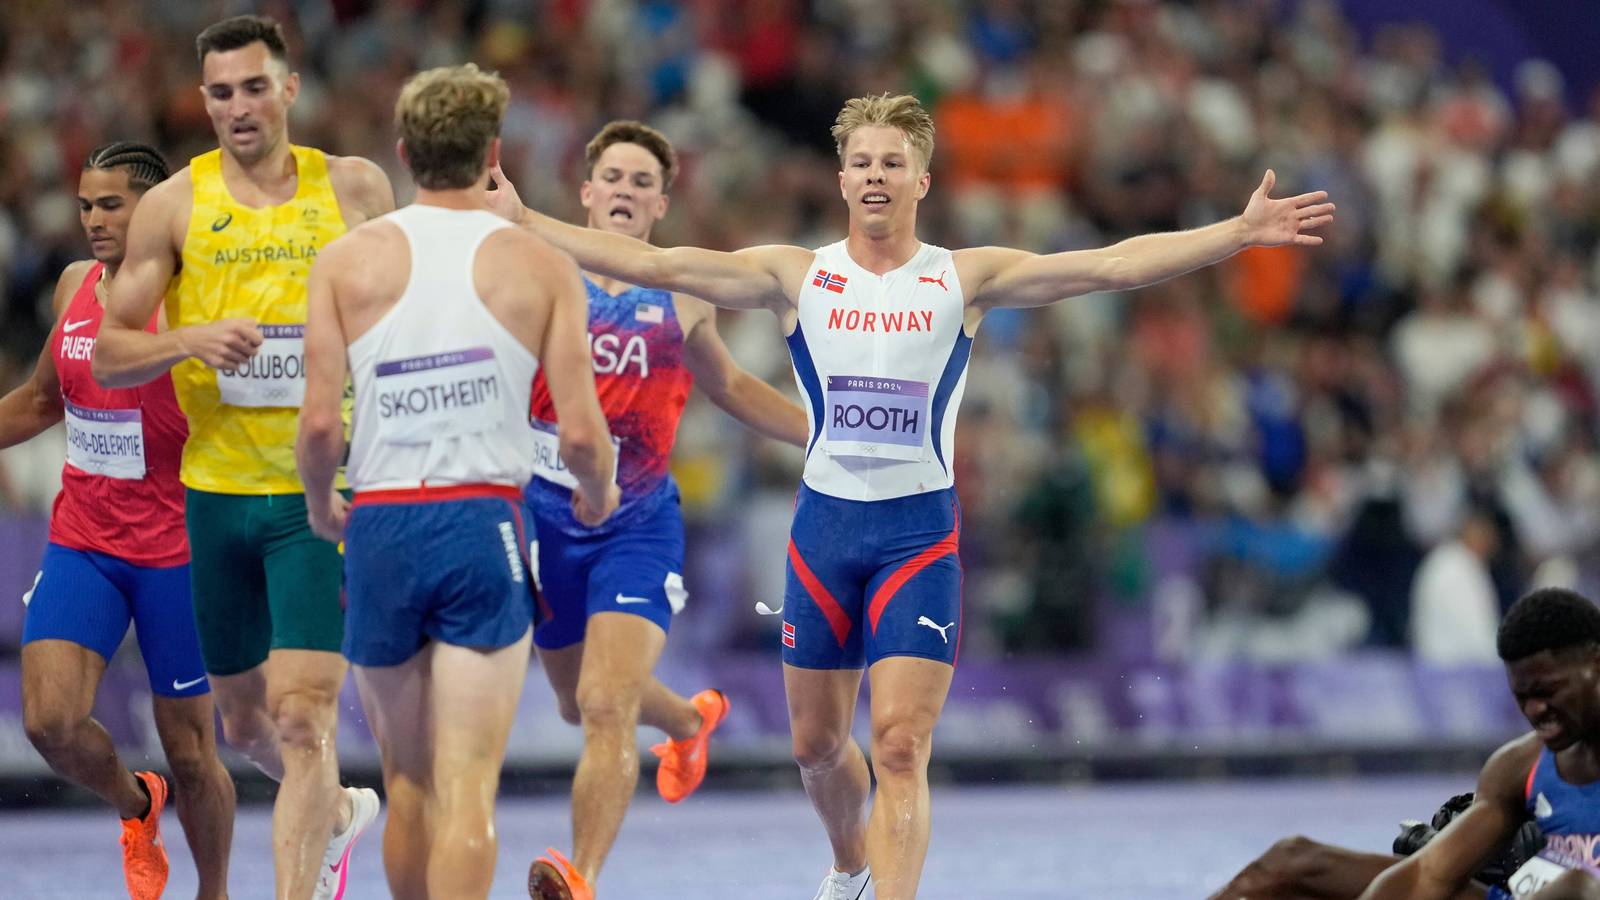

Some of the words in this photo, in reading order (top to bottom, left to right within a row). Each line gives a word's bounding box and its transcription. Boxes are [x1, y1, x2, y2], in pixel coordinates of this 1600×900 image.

[214, 245, 317, 265] AUSTRALIA
[827, 308, 934, 333] NORWAY
[61, 334, 97, 361] PUER
[221, 354, 305, 379] GOLUBO
[379, 373, 499, 419] SKOTHEIM
[847, 379, 874, 389] PARIS
[876, 380, 902, 391] 2024
[833, 404, 919, 434] ROOTH
